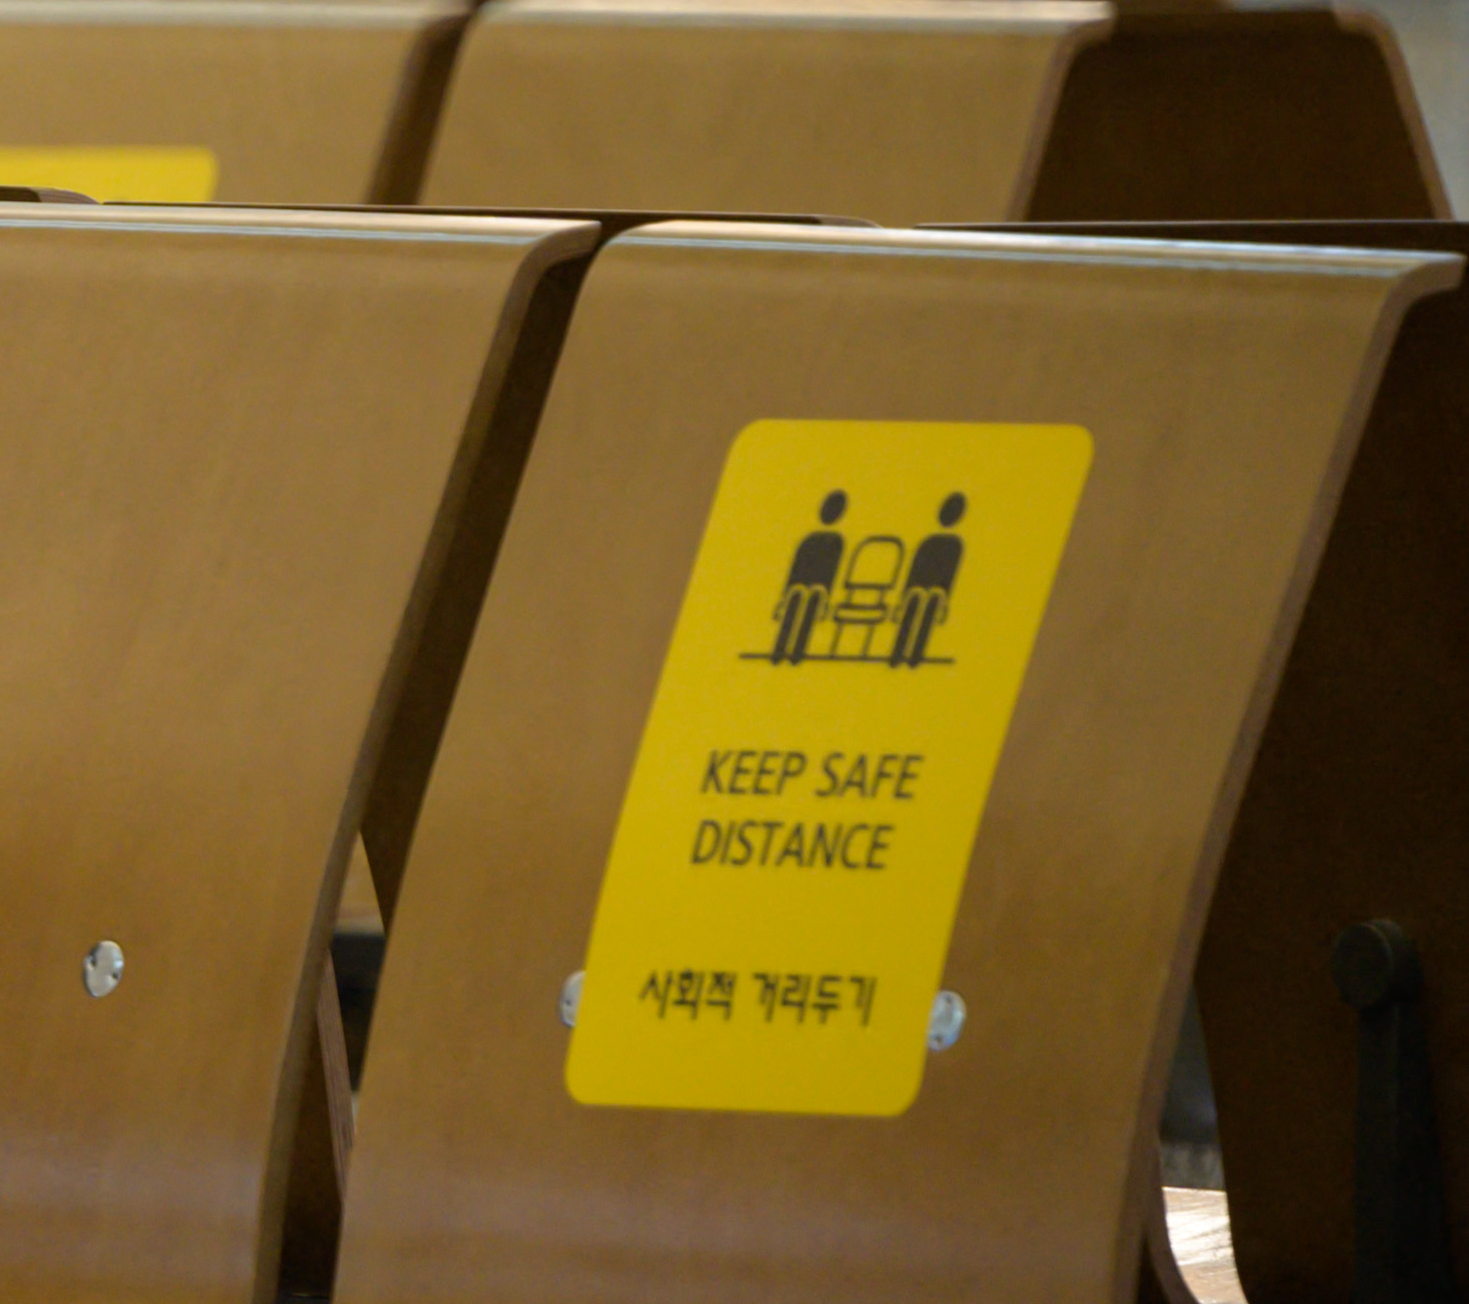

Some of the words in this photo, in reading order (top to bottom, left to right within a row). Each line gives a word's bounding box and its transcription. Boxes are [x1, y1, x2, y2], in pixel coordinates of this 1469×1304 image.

[700, 750, 808, 795] KEEP
[814, 752, 925, 800] SAFE
[690, 819, 896, 870] DISTANCE
[639, 968, 738, 1021] 사회적
[752, 972, 878, 1028] 거리두기
